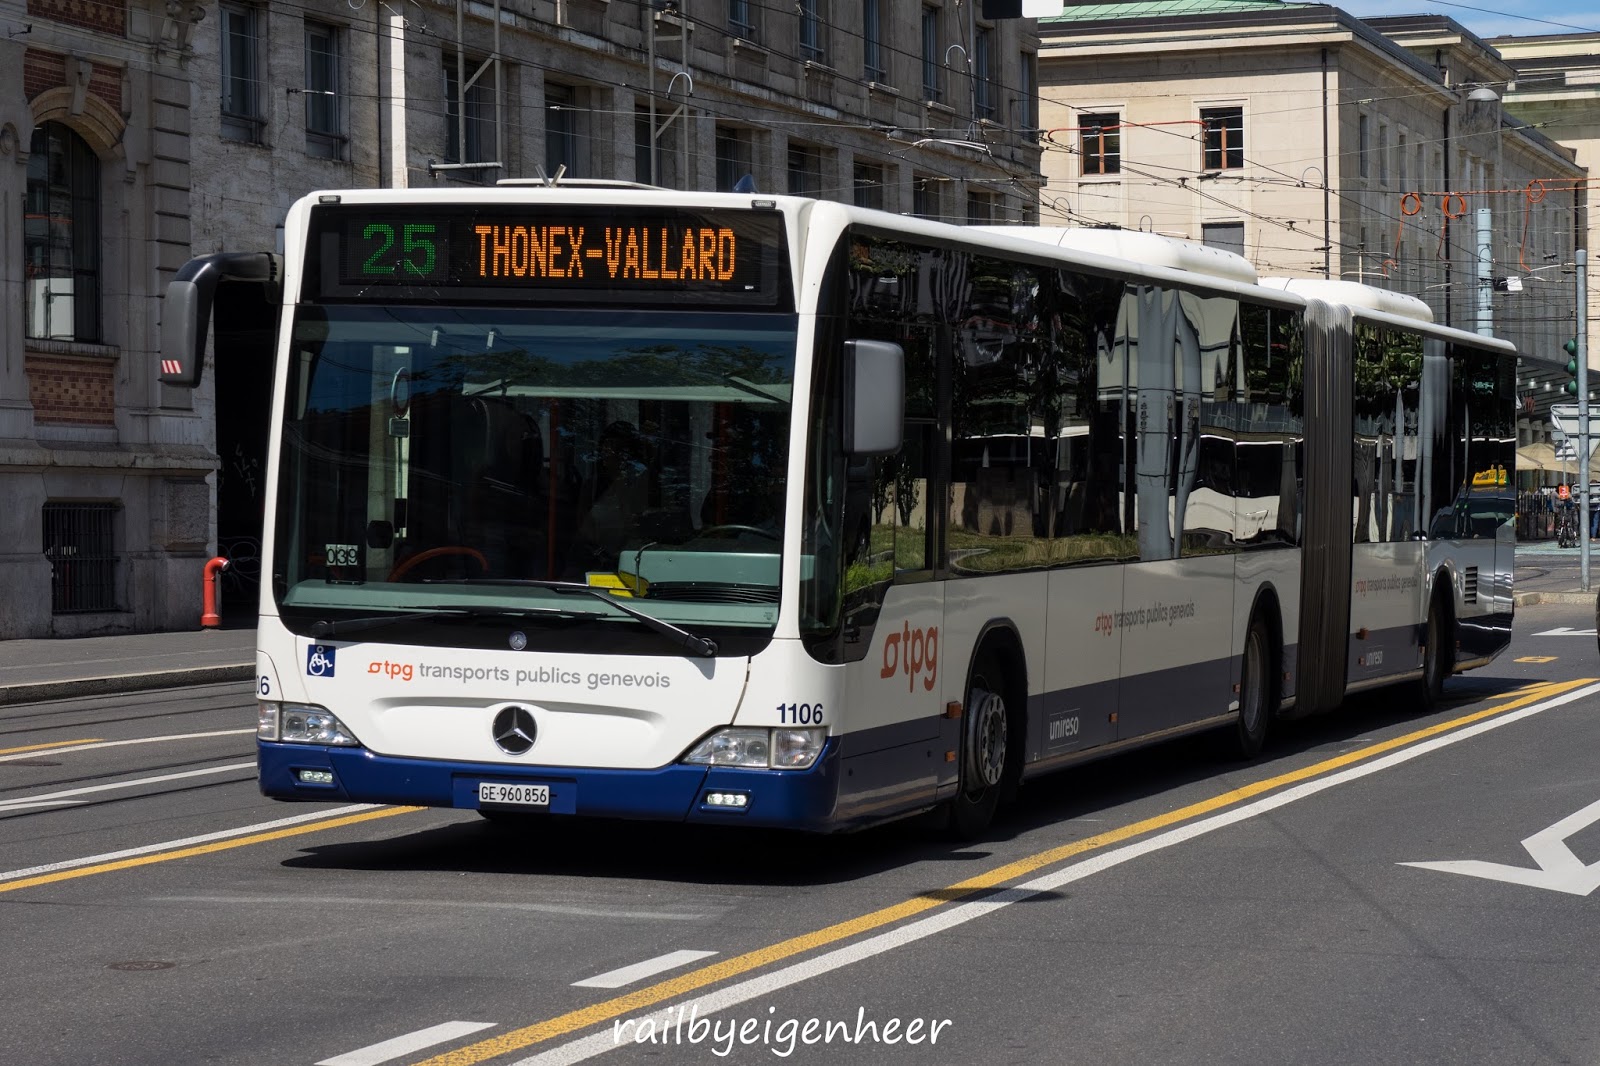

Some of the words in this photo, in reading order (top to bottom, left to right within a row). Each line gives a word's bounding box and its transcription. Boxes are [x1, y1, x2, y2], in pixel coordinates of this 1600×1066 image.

[363, 224, 436, 276] 25
[475, 225, 736, 281] THONEX-VALLARD
[327, 548, 358, 564] 039
[1114, 609, 1145, 633] transports
[1146, 601, 1168, 630] publics
[1168, 597, 1195, 627] genevois
[419, 662, 510, 684] transports
[516, 666, 581, 687] publics
[587, 672, 671, 690] genevois
[776, 703, 824, 725] 1106
[1050, 716, 1079, 740] unireso
